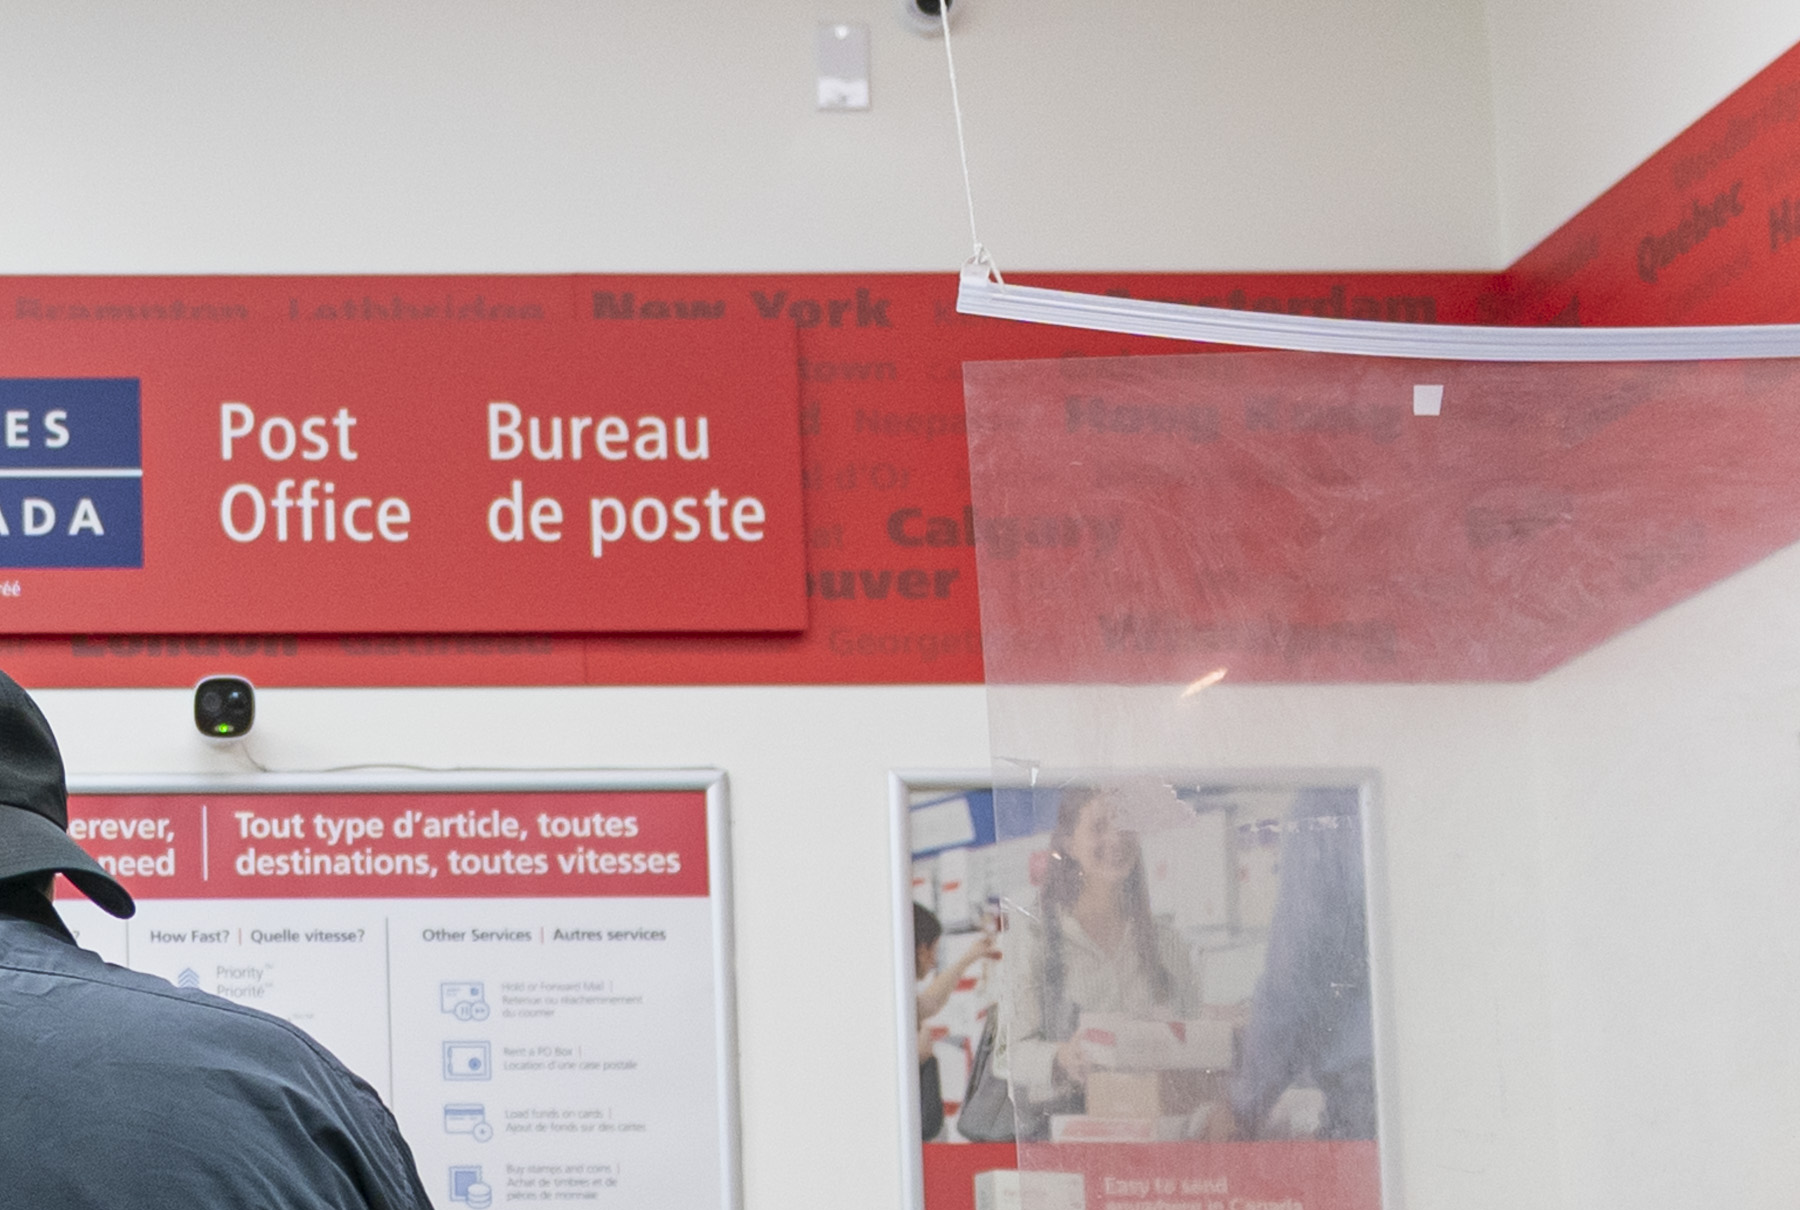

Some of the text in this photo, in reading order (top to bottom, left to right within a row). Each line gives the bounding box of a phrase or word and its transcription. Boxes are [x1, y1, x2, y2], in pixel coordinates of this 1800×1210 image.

[750, 288, 893, 328] York
[219, 403, 358, 462] Post
[488, 403, 709, 462] Bureau
[219, 481, 412, 543] Office
[488, 482, 766, 558] de poste
[236, 810, 638, 846] Tout type d'article, toutes
[236, 848, 681, 879] destinations, toutes vitesses
[150, 930, 230, 943] How Fast?
[250, 929, 365, 944] Quelle vitesse?
[422, 929, 532, 942] Other Services
[553, 929, 666, 942] Autres services
